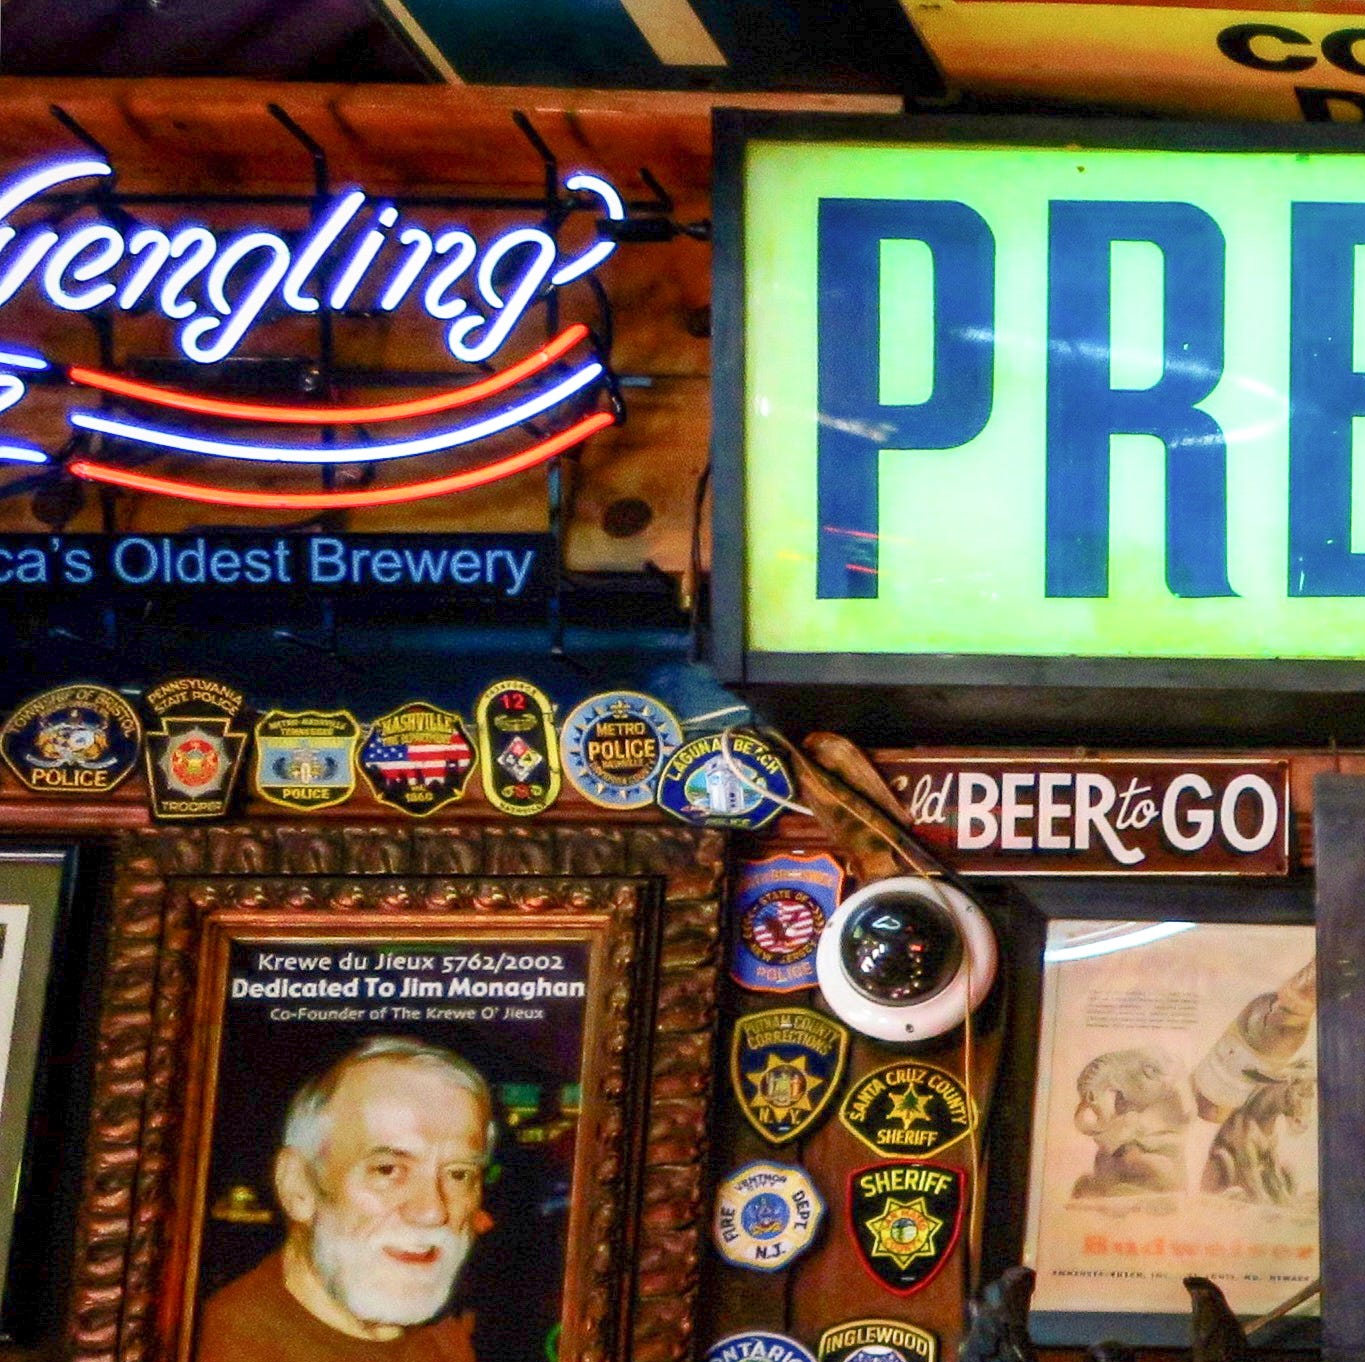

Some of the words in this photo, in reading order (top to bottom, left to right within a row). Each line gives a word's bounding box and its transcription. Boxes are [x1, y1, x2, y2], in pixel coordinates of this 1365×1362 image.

[0, 160, 626, 363] uengling
[113, 538, 292, 584] Oldest
[310, 538, 534, 594] Brewery
[147, 678, 244, 706] PENNSYLVANIA
[192, 691, 239, 717] POLICE
[502, 694, 527, 710] 12
[596, 722, 645, 738] METRO
[588, 740, 656, 762] POLICE
[666, 736, 721, 781] LAGUNA
[31, 769, 107, 788] POLICE
[161, 800, 223, 812] TROOPER
[282, 788, 331, 800] POLICE
[957, 772, 1145, 865] BEER
[1117, 777, 1159, 830] to
[1161, 773, 1278, 852] GO
[258, 953, 331, 971] Krewe
[339, 953, 367, 971] du
[374, 952, 435, 971] Jieux
[441, 952, 565, 976] 5762/2002
[232, 978, 361, 999] Dedicated
[366, 979, 396, 999] To
[399, 978, 443, 999] Jim
[448, 979, 586, 1002] Monaghan
[269, 1006, 365, 1021] Co-Founder
[369, 1005, 389, 1021] of
[392, 1006, 421, 1020] The
[426, 1006, 476, 1021] Krewe
[849, 1079, 885, 1123] SANTA
[886, 1069, 925, 1087] CRUZ
[927, 1075, 968, 1125] COUNTY
[877, 1129, 938, 1146] SHERIFF
[860, 1170, 951, 1198] SHERIFF
[792, 1190, 811, 1232] DEPT
[1083, 1234, 1316, 1260] Budweiser
[826, 1327, 929, 1356] INGLEWOOD
